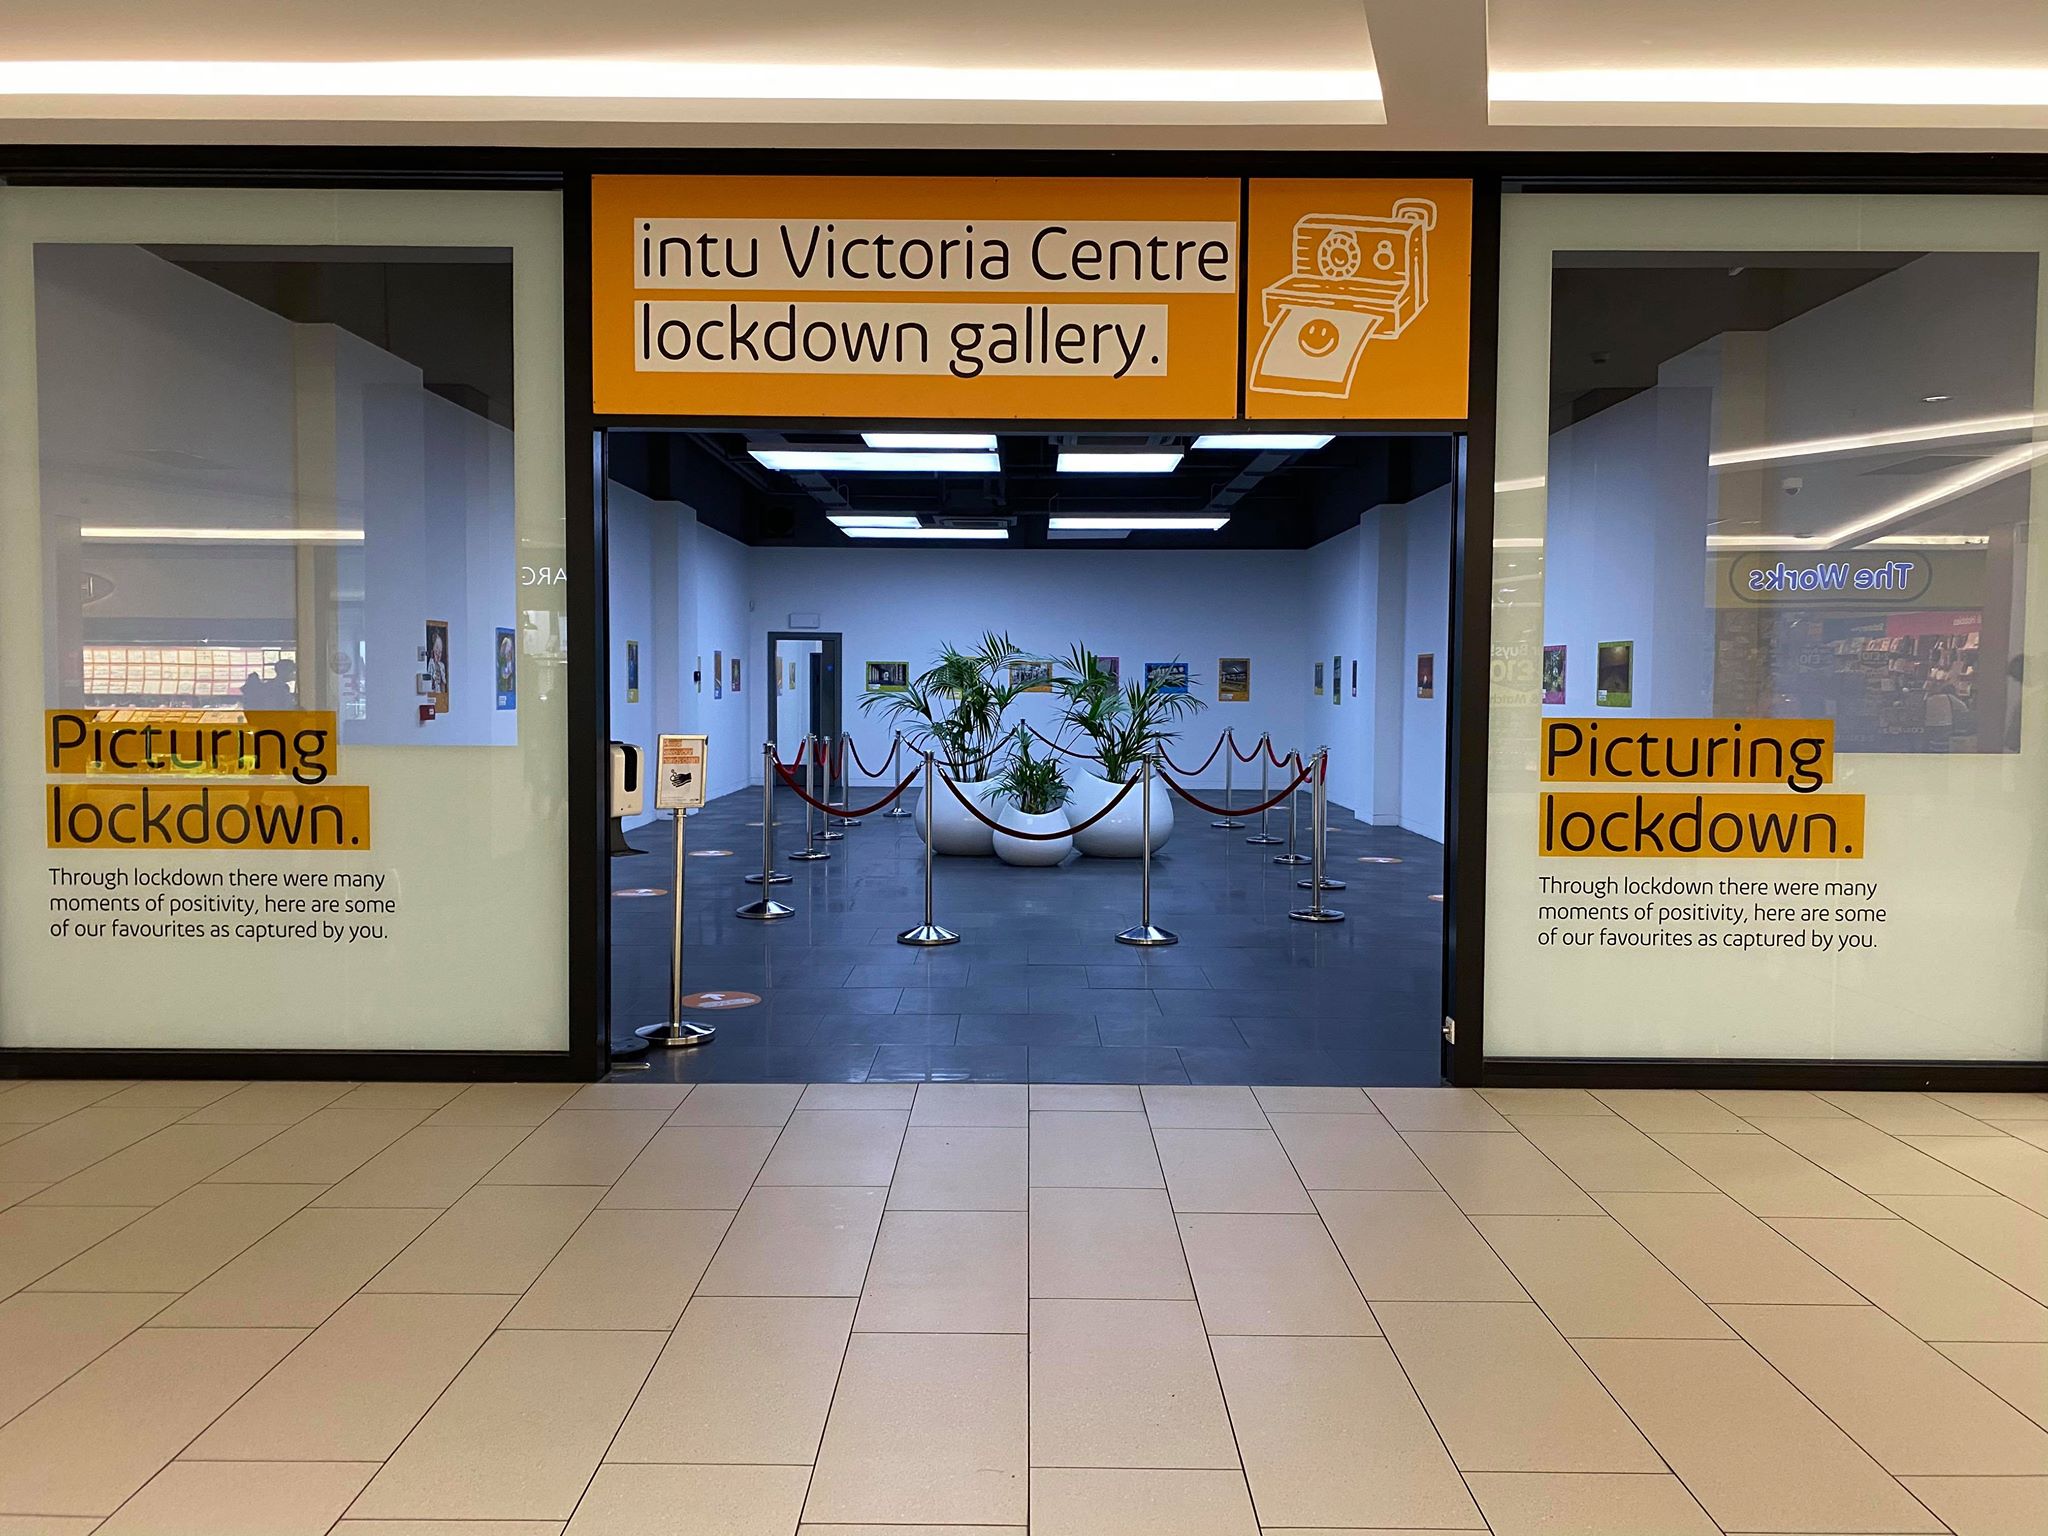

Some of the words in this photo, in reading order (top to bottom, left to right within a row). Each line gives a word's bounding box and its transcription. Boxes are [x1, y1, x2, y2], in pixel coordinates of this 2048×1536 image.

[641, 223, 759, 279] intu
[781, 223, 1011, 280] Victoria
[1030, 224, 1229, 283] Centre
[641, 303, 928, 363] lockdown
[949, 305, 1160, 380] gallery.
[51, 714, 328, 784] Picturing
[1547, 722, 1826, 793] Picturing
[53, 787, 360, 845] lockdown.
[1545, 795, 1853, 854] lockdown.
[48, 867, 129, 890] Through
[134, 868, 223, 886] lockdown
[229, 869, 278, 886] there
[283, 873, 328, 887] were
[334, 874, 385, 892] many
[1538, 875, 1618, 899] Through
[1624, 876, 1713, 895] lockdown
[1719, 877, 1768, 895] there
[1774, 882, 1819, 896] were
[1825, 883, 1877, 900] many
[50, 897, 140, 911] moments
[145, 893, 165, 911] of
[170, 894, 259, 916] positivity,
[265, 894, 306, 913] here
[311, 899, 340, 913] are
[345, 899, 396, 913] some
[1538, 905, 1629, 920] moments
[1634, 902, 1654, 920] of
[1659, 903, 1748, 925] positivity,
[1754, 903, 1795, 921] here
[1801, 908, 1830, 922] are
[1835, 908, 1886, 922] some
[50, 919, 70, 937] of
[74, 923, 106, 937] our
[112, 919, 205, 937] favourites
[210, 924, 230, 937] as
[235, 920, 317, 942] captured
[323, 920, 344, 943] by
[349, 925, 388, 943] you.
[1538, 927, 1558, 945] of
[1562, 931, 1595, 946] our
[1600, 927, 1693, 946] favourites
[1698, 932, 1717, 947] as
[1723, 929, 1805, 951] captured
[1812, 929, 1833, 952] by
[1838, 934, 1877, 952] you.
